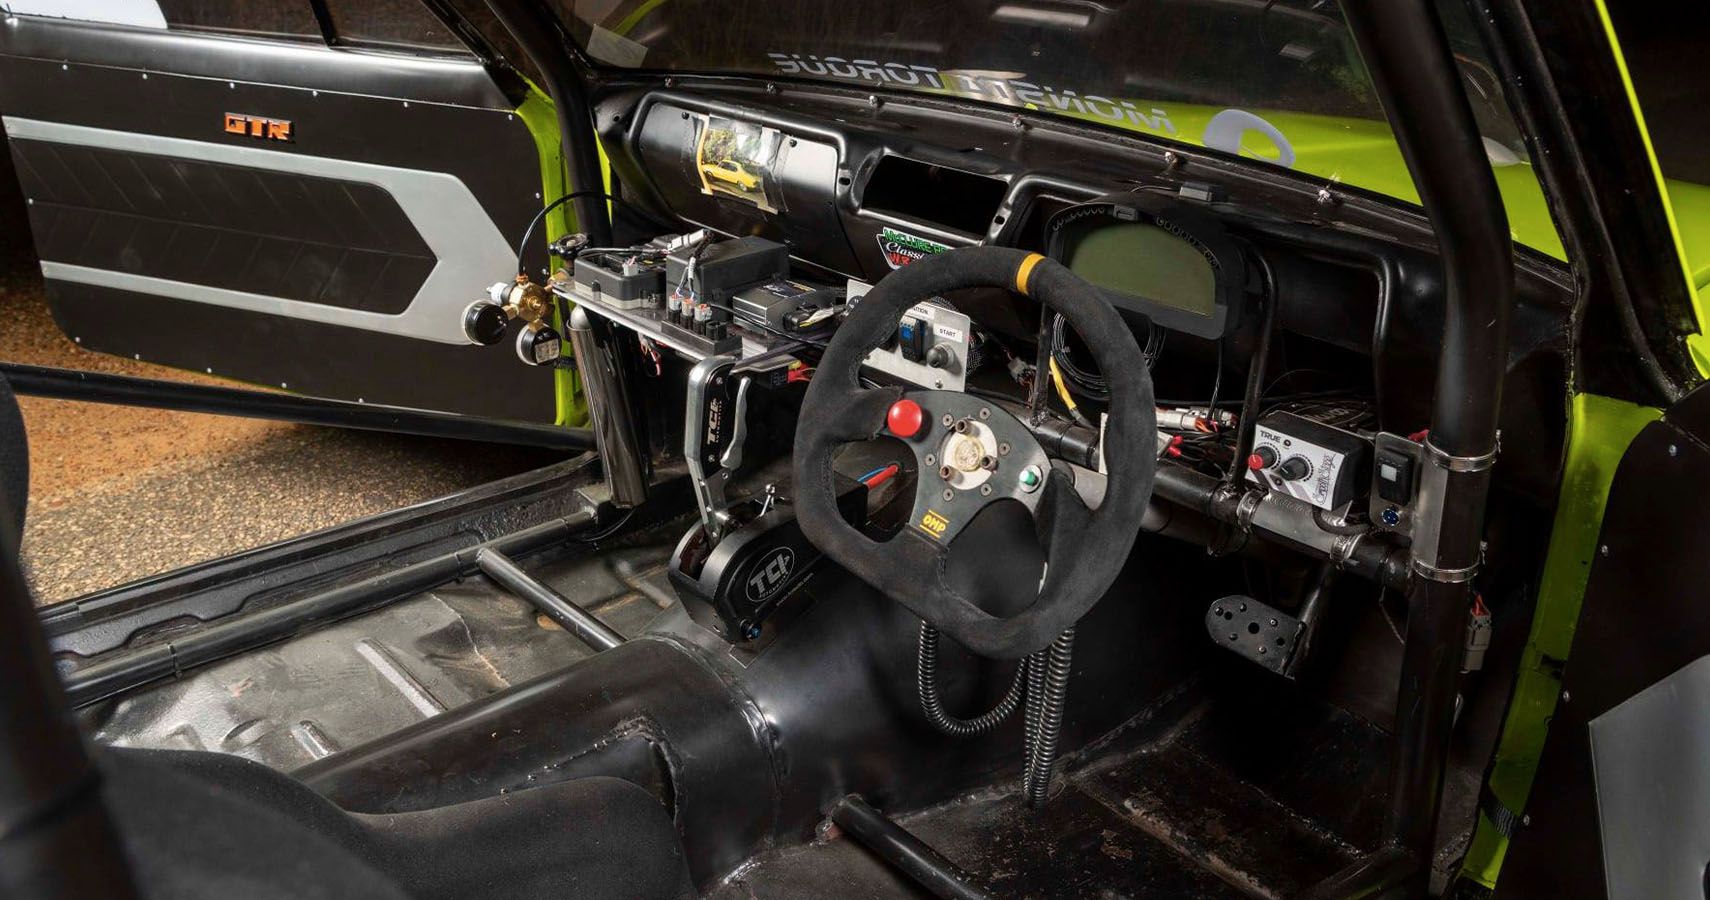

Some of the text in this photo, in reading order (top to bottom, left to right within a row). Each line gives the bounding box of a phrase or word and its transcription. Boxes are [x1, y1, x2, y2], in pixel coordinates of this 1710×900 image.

[224, 112, 292, 140] GTR
[939, 328, 957, 338] START
[1260, 430, 1282, 444] TRUE
